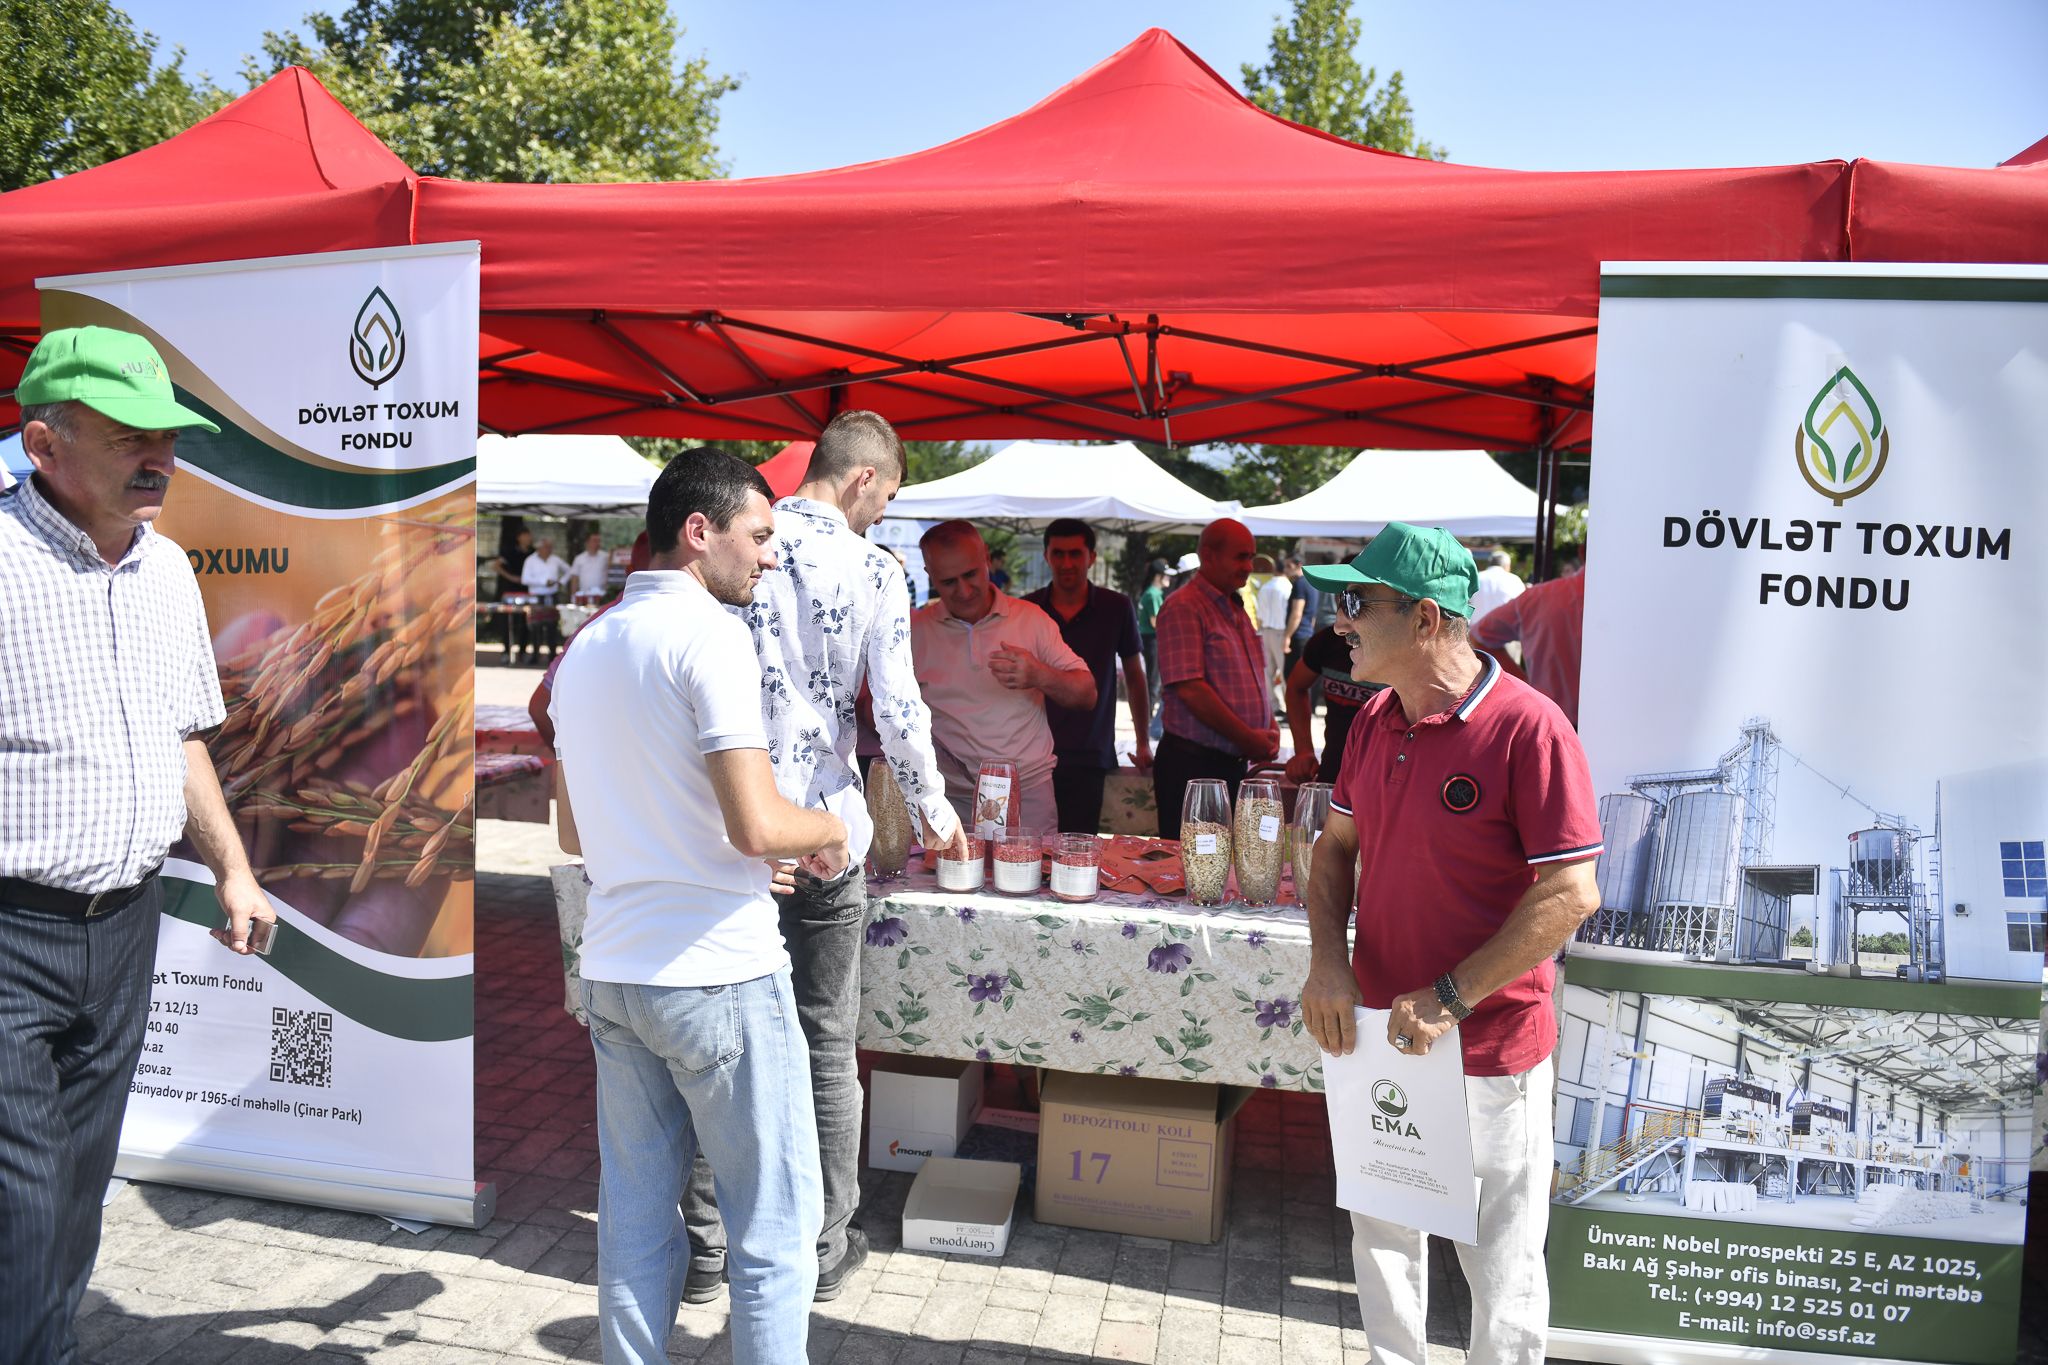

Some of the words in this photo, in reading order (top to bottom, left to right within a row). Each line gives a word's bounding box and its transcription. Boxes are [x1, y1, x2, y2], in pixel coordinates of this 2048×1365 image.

[298, 403, 378, 425] DÖVLƏT
[383, 400, 459, 420] TOXUM
[341, 431, 412, 451] FONDU
[1662, 509, 1842, 553] DÖVLƏT
[1855, 521, 2011, 561] TOXUM
[186, 547, 289, 575] OXUMU
[1759, 573, 1911, 612] FONDU
[152, 972, 168, 985] ət
[171, 971, 219, 988] Toxum
[223, 974, 263, 993] Fondu
[165, 1001, 199, 1016] 12/13
[147, 1021, 162, 1033] 40
[165, 1022, 179, 1035] 40
[143, 1042, 164, 1053] v.az
[135, 1063, 172, 1076] .gov.az
[185, 1090, 198, 1103] pr
[201, 1090, 241, 1107] 1965-ci
[243, 1097, 290, 1113] məhəllə
[293, 1101, 329, 1118] (Çinar
[332, 1107, 362, 1125] Park)
[1062, 1112, 1150, 1134] DEPOZİTOLU
[1157, 1124, 1192, 1138] KOLİ
[1371, 1114, 1422, 1140] EMA
[896, 1147, 933, 1157] mondi
[1067, 1149, 1112, 1185] 17
[929, 1236, 995, 1253] Снегурочка
[1588, 1224, 1656, 1249] Ünvan:
[1663, 1234, 1721, 1254] Nobel
[1726, 1242, 1824, 1264] prospekti
[1829, 1248, 1857, 1266] 25
[1864, 1251, 1881, 1272] E,
[1887, 1253, 1916, 1272] AZ
[1922, 1256, 1981, 1281] 1025,
[1583, 1252, 1626, 1271] Bakı
[1632, 1256, 1659, 1278] Ağ
[1665, 1259, 1724, 1280] Şəhər
[1730, 1267, 1769, 1285] ofis
[1775, 1268, 1842, 1294] binası,
[1848, 1276, 1889, 1295] 2-ci
[1895, 1282, 1983, 1304] mərtəbə
[1648, 1283, 1688, 1302] Tel.:
[1694, 1286, 1763, 1311] (+994)
[1770, 1294, 1796, 1312] 12
[1802, 1297, 1843, 1317] 525
[1849, 1302, 1876, 1320] 01
[1883, 1305, 1911, 1323] 07
[1679, 1311, 1750, 1334] E-mail:
[1756, 1319, 1876, 1345] info@ssf.az
